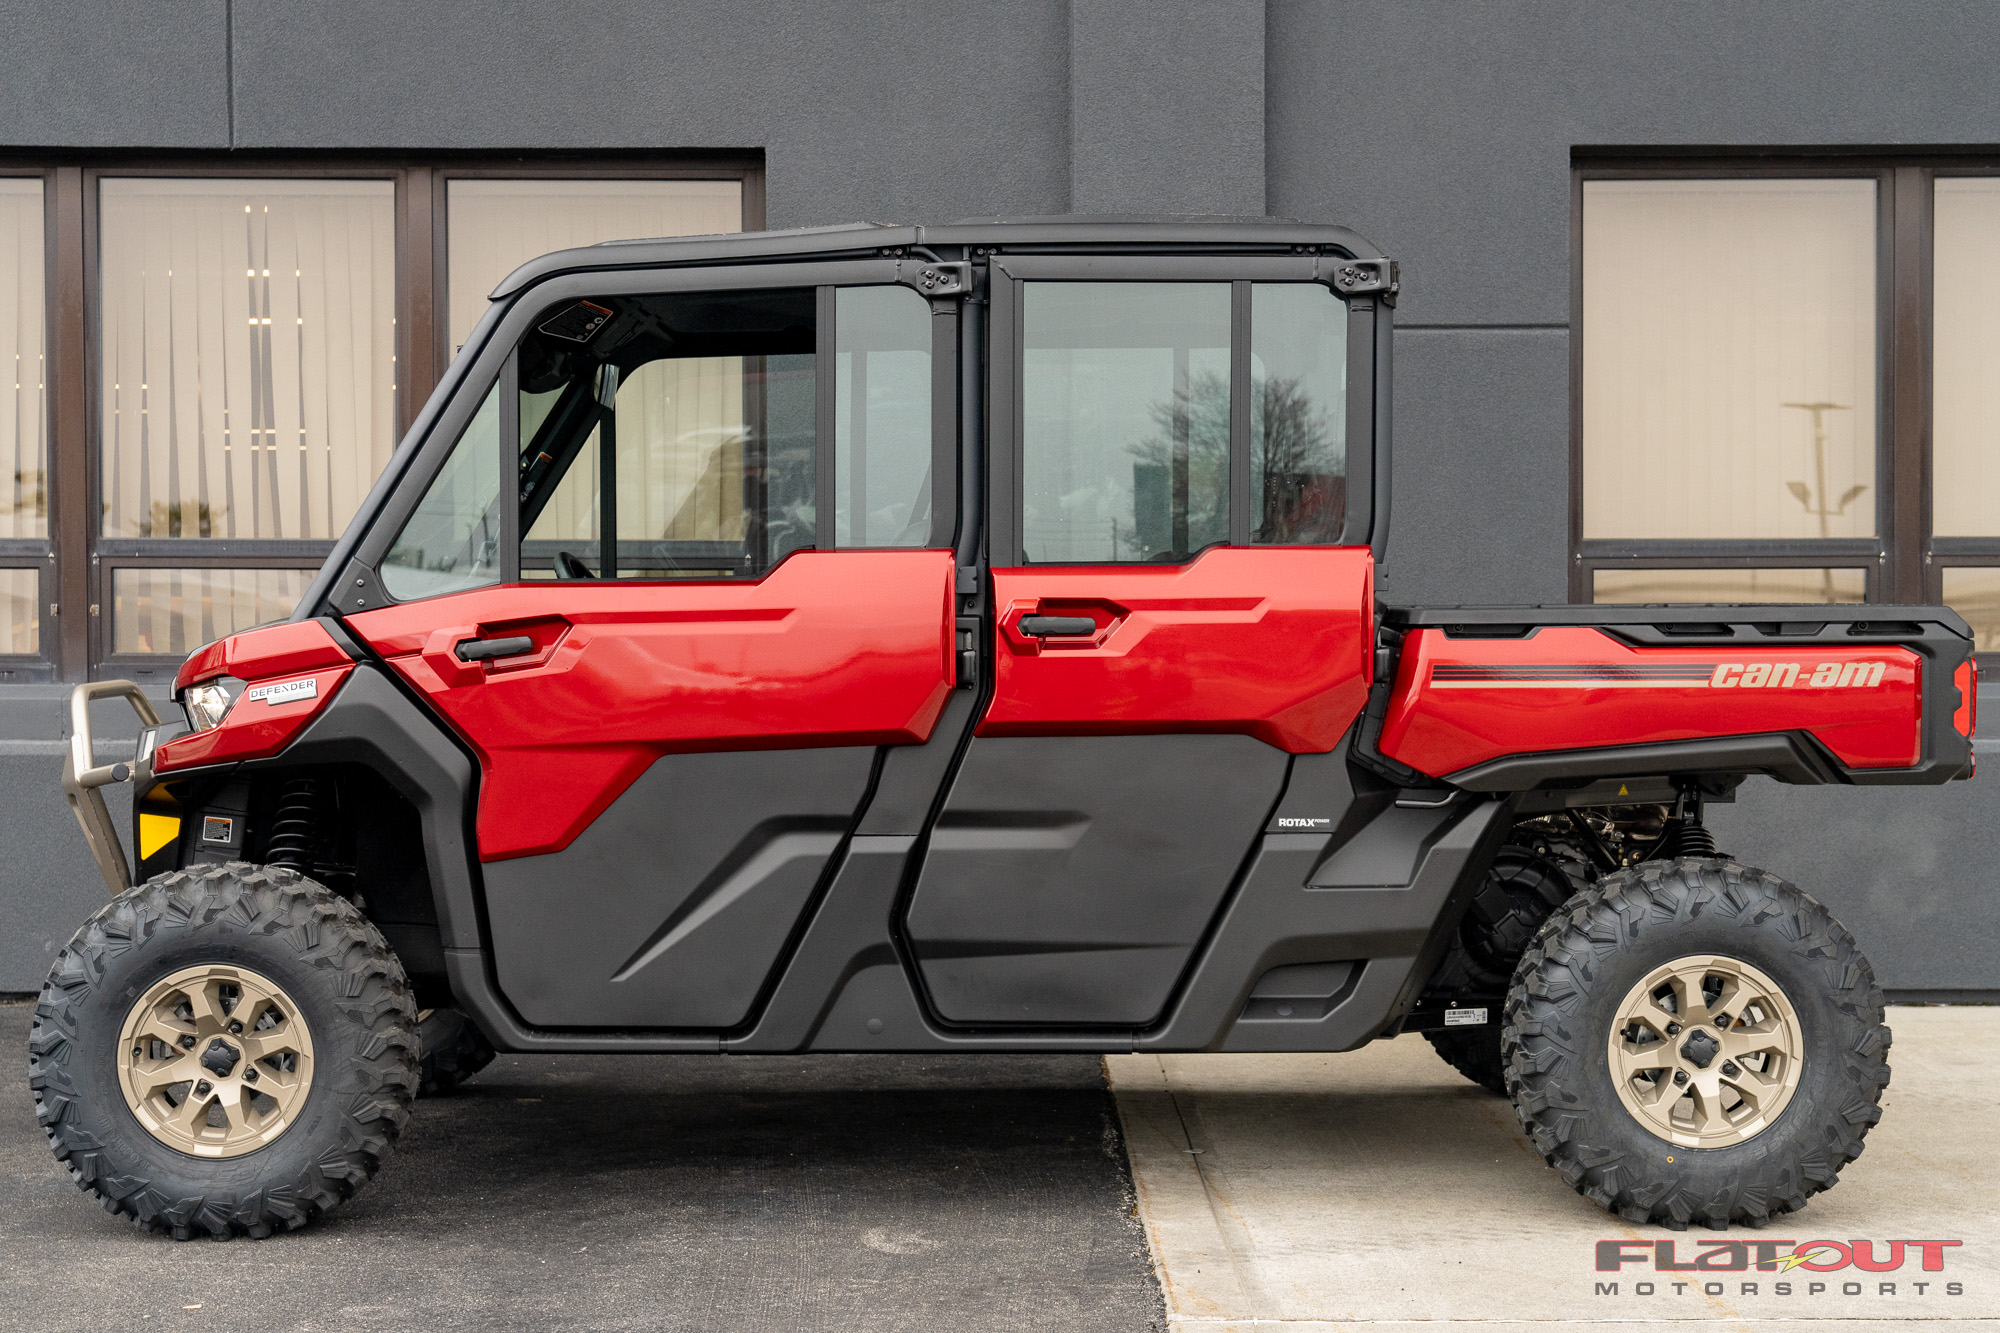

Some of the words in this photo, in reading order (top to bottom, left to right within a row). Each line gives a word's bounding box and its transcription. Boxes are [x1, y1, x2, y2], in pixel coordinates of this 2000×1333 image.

[1710, 662, 1887, 689] can-am
[250, 680, 314, 698] DEFENDER
[1278, 818, 1315, 827] ROTAX
